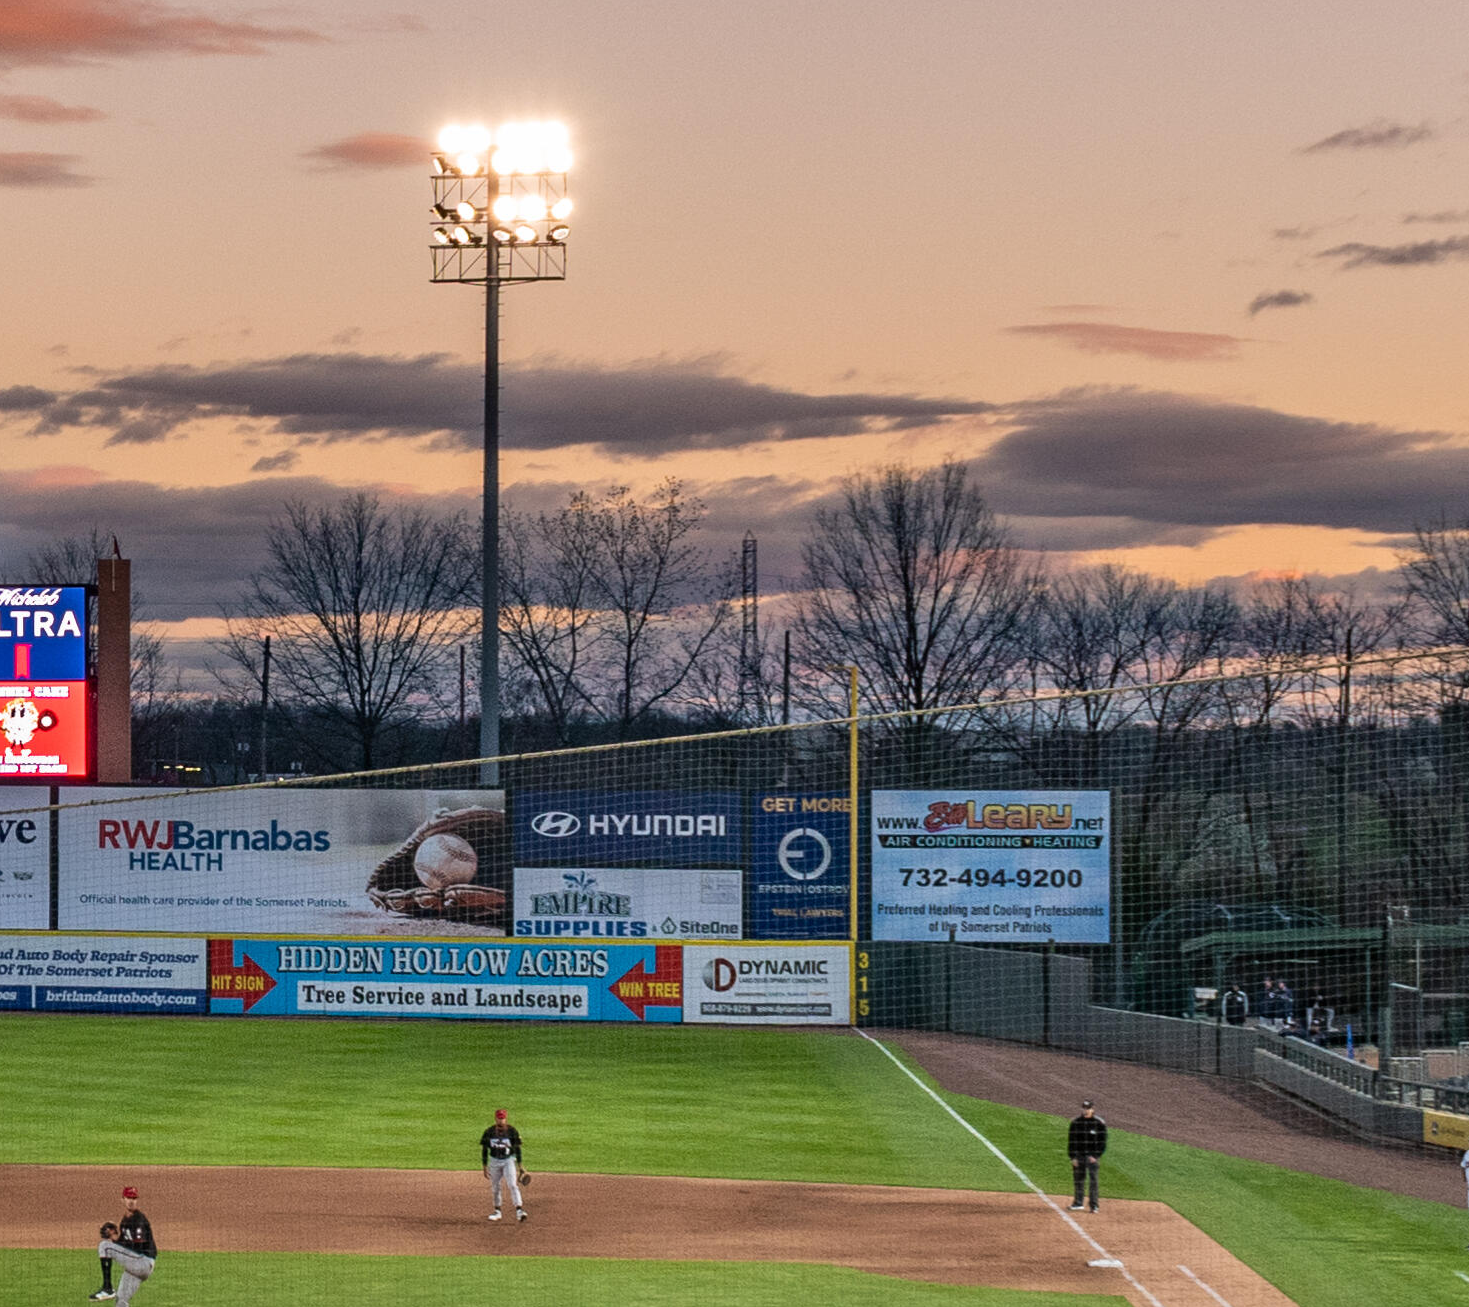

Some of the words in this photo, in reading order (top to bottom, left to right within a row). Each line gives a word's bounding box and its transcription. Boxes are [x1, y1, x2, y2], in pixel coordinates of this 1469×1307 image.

[762, 798, 797, 813] GET
[801, 798, 852, 813] MORE
[589, 815, 725, 837] HYUNDAI
[98, 819, 330, 852] RWJBarnabas
[886, 837, 910, 846] AIR
[916, 837, 1021, 847] CONDITIONING
[1033, 837, 1096, 847] HEATING
[129, 852, 223, 871] HEALTH
[899, 869, 1083, 888] 732-494-9200
[80, 894, 116, 904] Official
[118, 895, 150, 905] health
[153, 897, 174, 905] care
[177, 896, 220, 907] provider
[222, 896, 233, 906] of
[236, 897, 252, 906] the
[256, 897, 304, 907] Somerset
[530, 892, 631, 917] EMPIRE
[877, 904, 925, 915] Preferred
[929, 904, 968, 917] Heating
[971, 905, 990, 916] and
[993, 905, 1031, 918] Cooling
[1034, 905, 1104, 916] Professionals
[516, 920, 647, 937] SUPPLIES
[680, 921, 739, 934] SiteOne
[17, 949, 49, 962] Auto
[53, 950, 88, 965] Body
[91, 950, 137, 966] Repair
[139, 951, 199, 968] Sponsor
[278, 945, 385, 973] HIDDEN
[392, 947, 512, 975] HOLLOW
[517, 950, 609, 977] ACRES
[17, 965, 44, 977] The
[46, 966, 112, 978] Somerset
[117, 966, 172, 979] Patriots
[739, 960, 828, 975] DYNAMIC
[211, 975, 232, 989] HIT
[235, 975, 264, 990] SIGN
[619, 982, 645, 997] WIN
[648, 982, 680, 998] TREE
[303, 985, 346, 1004] Tree
[352, 986, 425, 1007] Service
[431, 988, 468, 1006] and
[474, 988, 583, 1013] Landscape
